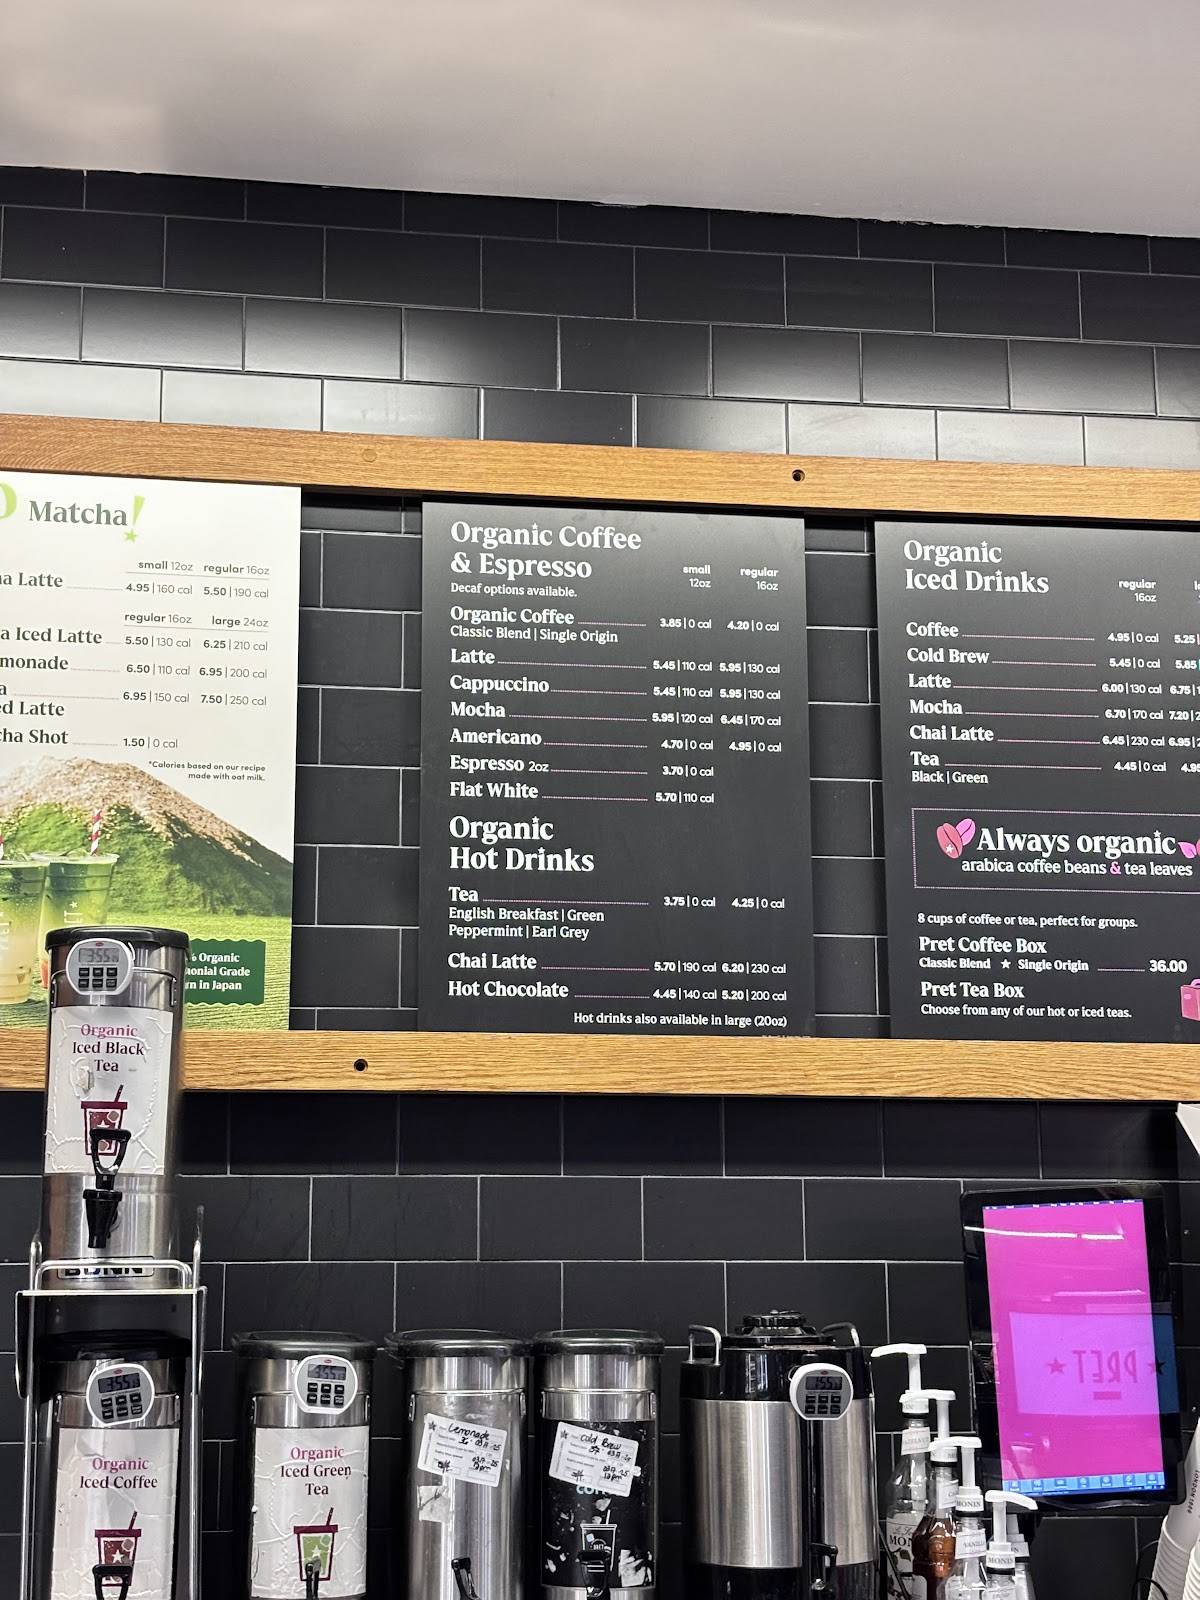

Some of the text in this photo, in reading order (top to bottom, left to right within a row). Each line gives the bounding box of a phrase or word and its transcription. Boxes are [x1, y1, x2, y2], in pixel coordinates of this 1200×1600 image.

[451, 521, 641, 549] Organic Coffee
[904, 540, 1002, 567] Organic
[138, 560, 270, 576] small 12oz regular 16oz
[451, 553, 592, 580] & Espresso
[682, 564, 778, 580] small regular
[18, 572, 63, 588] Latte
[689, 578, 778, 591] 12oz 16oz
[906, 569, 1049, 593] Iced Drinks
[1119, 579, 1156, 591] regular
[177, 584, 192, 595] cal
[254, 588, 269, 598] cal
[451, 583, 577, 598] Decaf options available.
[1135, 593, 1157, 602] 16oz
[125, 612, 269, 628] regular 16oz large 24oz
[450, 607, 574, 625] Organic Coffee
[16, 628, 102, 644] Iced Latte
[451, 626, 618, 644] Classic Blend Single Origin
[906, 622, 958, 637] Coffee
[451, 649, 495, 664] Latte
[907, 648, 989, 663] Cold Brew
[450, 675, 549, 695] Cappuccino
[908, 673, 951, 688] Latte
[19, 701, 65, 716] Latte
[451, 702, 505, 718] Mocha
[910, 699, 962, 715] Mocha
[28, 729, 69, 744] Shot
[450, 728, 542, 745] Americano
[910, 726, 994, 741] Chai Latte
[450, 755, 549, 774] Espresso 2oz
[910, 752, 939, 765] Tea
[187, 762, 211, 771] based
[241, 765, 266, 773] recipe
[188, 772, 211, 780] made
[247, 774, 265, 782] milk.
[912, 771, 988, 784] Black Green
[450, 782, 538, 798] Flat White
[450, 816, 554, 844] Organic
[977, 827, 1177, 859] Always organic
[450, 847, 594, 872] Hot Drinks
[962, 858, 1193, 876] arabica coffee beans & tea leaves
[448, 887, 478, 902] Tea
[449, 908, 604, 922] English Breakfast Green
[918, 913, 1138, 929] 8 cups of coffee or tea, perfect for groups.
[449, 925, 589, 941] Peppermint Earl Grey
[919, 936, 1047, 953] Pret Coffee Box
[199, 953, 240, 964] Organic
[448, 953, 537, 970] Chai Latte
[919, 958, 1187, 972] Classic Blend Single Origin 36.00
[219, 967, 250, 976] Grade
[702, 962, 716, 972] cal
[199, 980, 242, 992] in Japan
[448, 981, 569, 998] Hot Chocolate
[921, 982, 1024, 998] Pret Tea Box
[921, 1004, 1132, 1018] Choose from any of our hot or iced teas.
[574, 1012, 787, 1028] Hot drinks also available in large (20oz)
[80, 1024, 138, 1038] Organic
[73, 1041, 144, 1057] Iced Black
[94, 1059, 119, 1072] Tea
[290, 1447, 344, 1461] Organic
[92, 1457, 149, 1472] Organic
[280, 1464, 352, 1478] Iced Green
[80, 1476, 158, 1489] Iced Coffee
[305, 1483, 329, 1495] Tea
